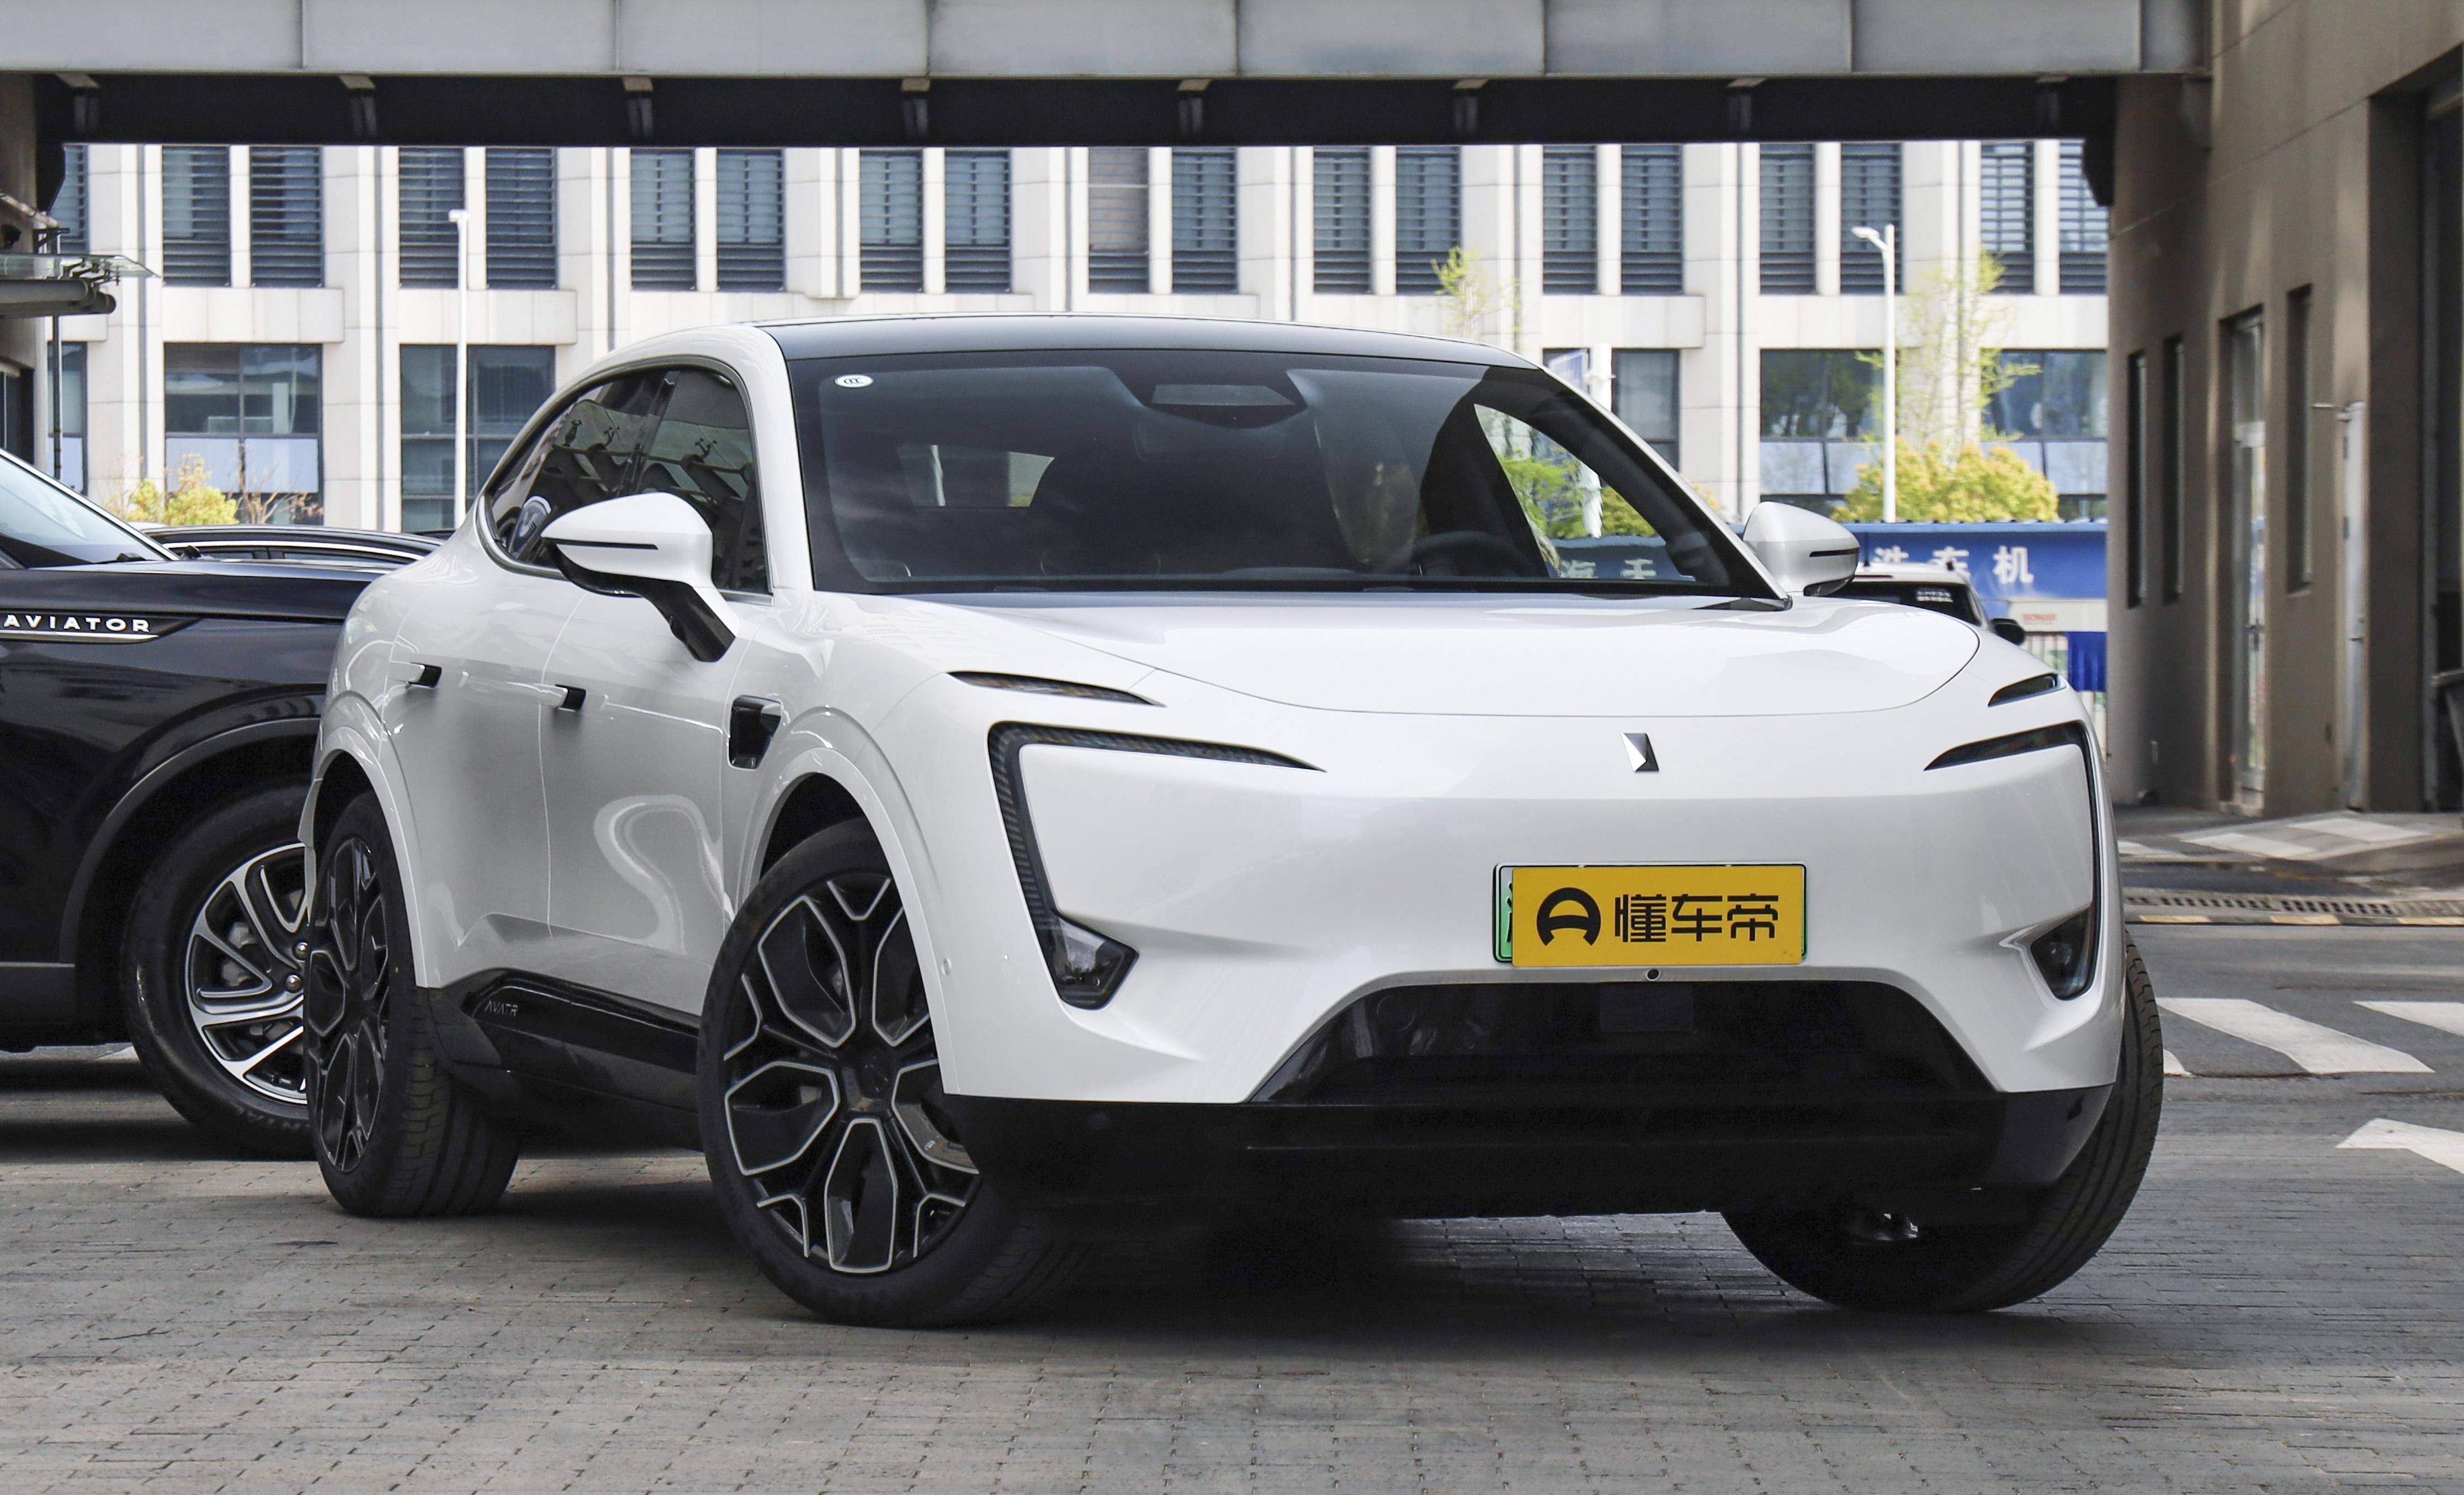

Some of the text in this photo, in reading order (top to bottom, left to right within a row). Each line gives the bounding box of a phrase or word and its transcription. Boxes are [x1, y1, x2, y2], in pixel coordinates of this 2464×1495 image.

[3, 614, 150, 633] AVIATOR
[1615, 893, 1779, 942] 懂车帝
[485, 1000, 519, 1017] AVATR
